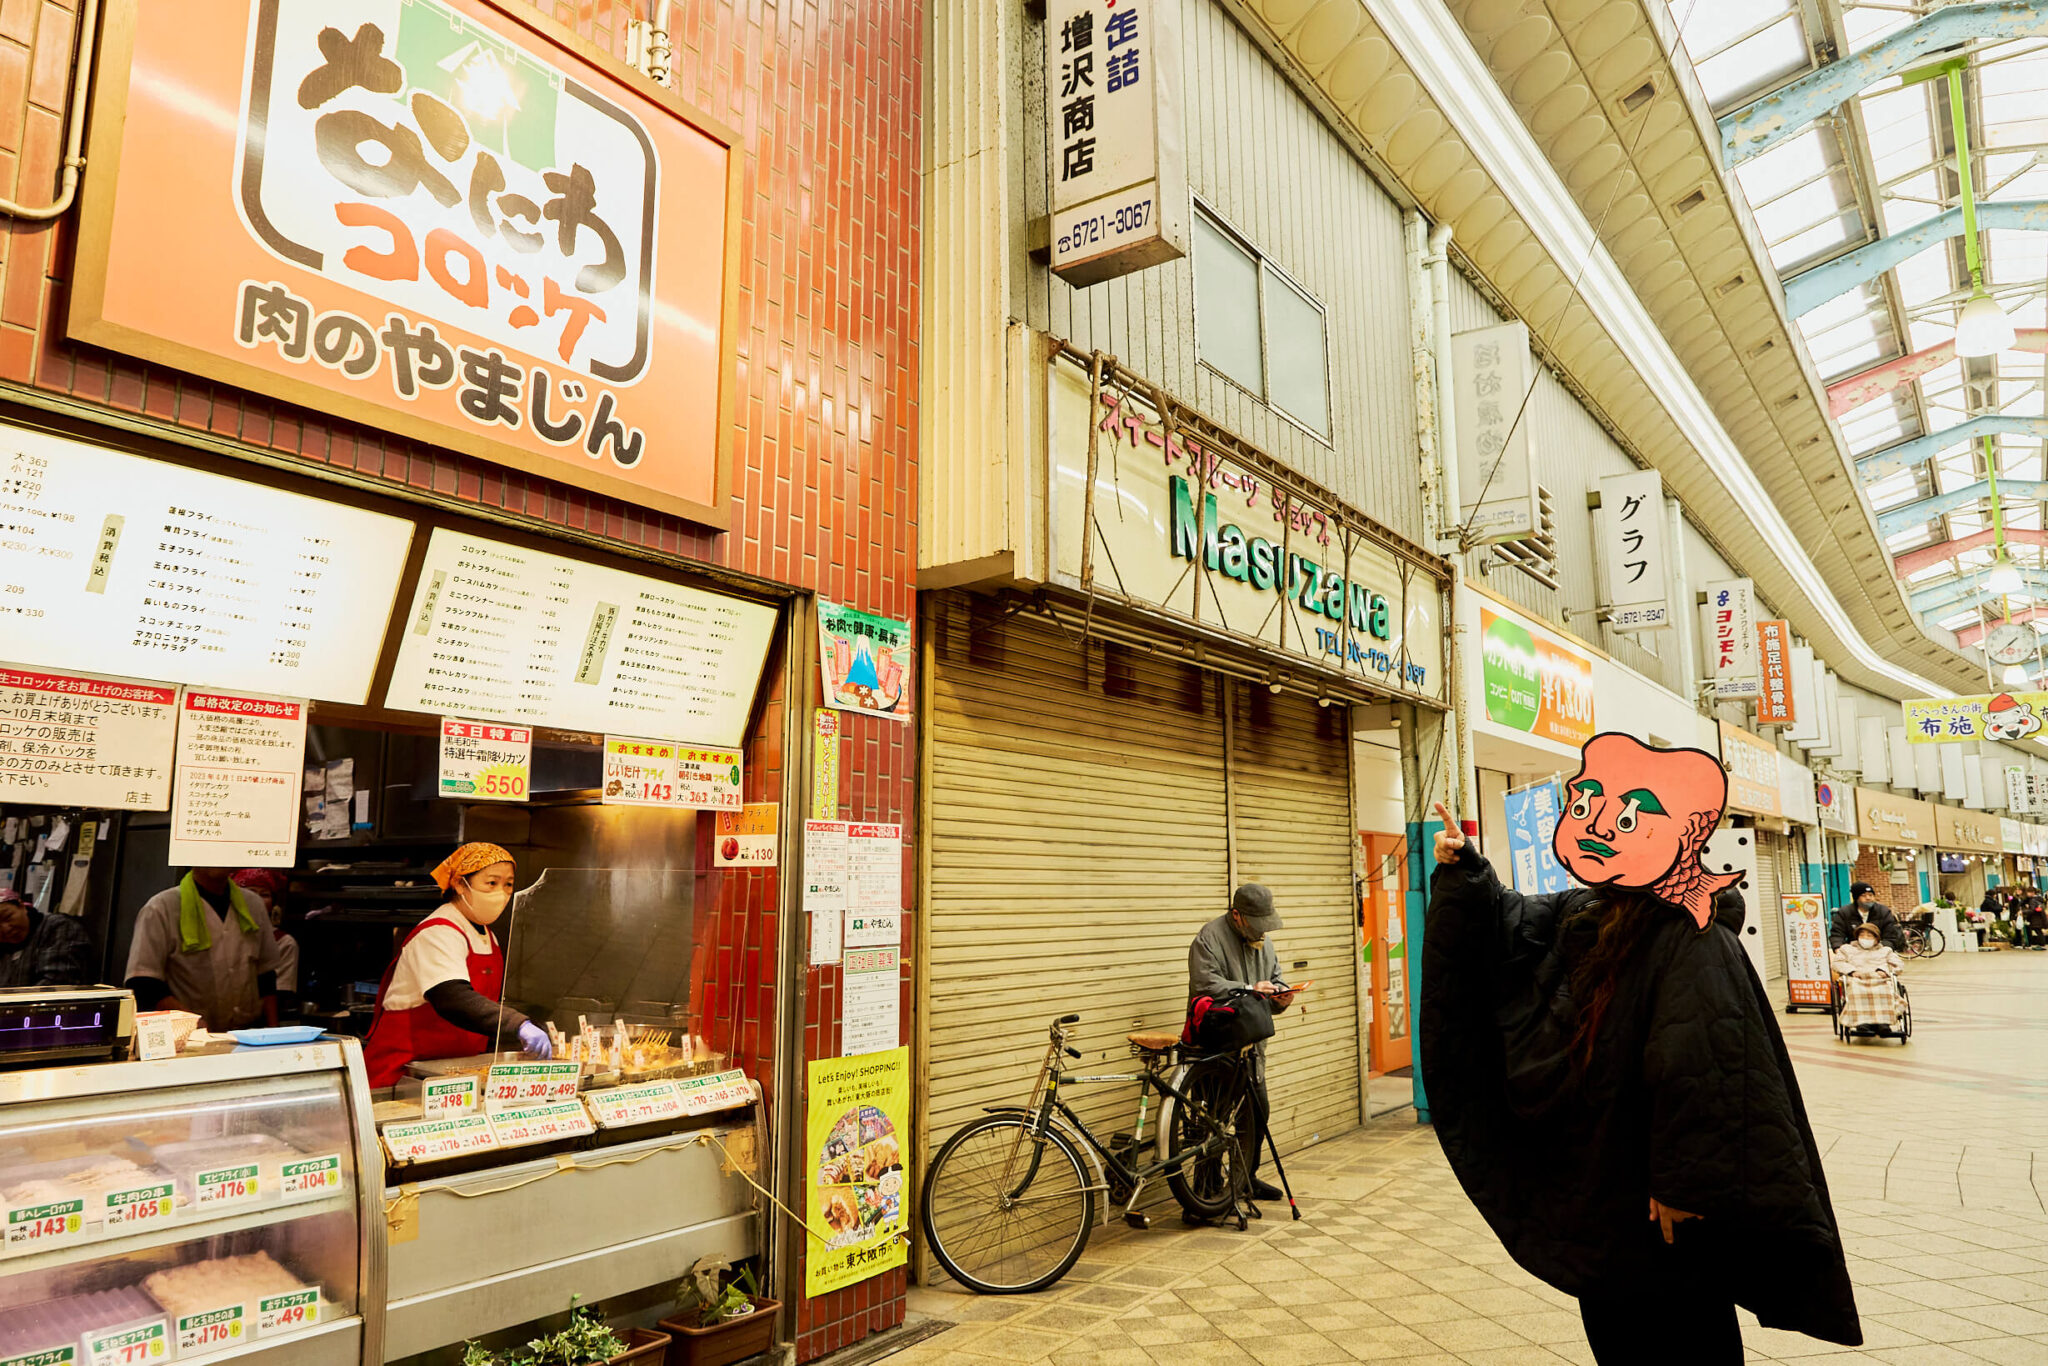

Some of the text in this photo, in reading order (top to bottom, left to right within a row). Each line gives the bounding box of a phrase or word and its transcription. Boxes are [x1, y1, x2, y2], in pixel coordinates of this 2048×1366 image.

[1061, 10, 1096, 182] 増沢商店
[298, 23, 626, 293] なにわ
[1073, 200, 1151, 249] 6721-3067
[334, 202, 606, 364] コロッケ
[240, 284, 642, 465] 肉のやまじん
[29, 456, 48, 468] 363
[1620, 494, 1648, 584] グラフ
[94, 526, 117, 577] 消費税込
[1170, 474, 1390, 641] Masuzawa
[138, 615, 202, 632] スコッチエッグ
[132, 639, 187, 653] ポテトサラダ
[135, 630, 198, 645] マカロニサラダ
[1315, 627, 1342, 657] TEL
[1716, 610, 1735, 668] ヨシモト
[1764, 625, 1787, 718] 布施足代整骨院
[193, 695, 295, 716] 価格改定のお知らせ
[448, 723, 527, 742] 本日特価
[1918, 715, 1975, 737] 布施
[445, 736, 479, 748] 黒毛和牛
[618, 743, 669, 758] おすすめ
[444, 746, 526, 764] 特選牛霜降りカツ
[687, 751, 734, 764] おすすめ
[607, 763, 640, 779] しいたけ
[479, 774, 524, 796] ¥550
[125, 791, 152, 804] 店主
[288, 1160, 332, 1175] イカの串
[215, 1181, 245, 1199] ¥176
[299, 1171, 325, 1189] ¥104
[114, 1187, 165, 1205] 牛肉の串
[125, 1200, 158, 1221] ¥165
[29, 1216, 66, 1239] ¥143
[266, 1293, 310, 1311] ポテトフライ
[276, 1306, 304, 1326] ¥49
[100, 1327, 154, 1351] 玉ねぎフライ
[197, 1323, 228, 1344] ¥176
